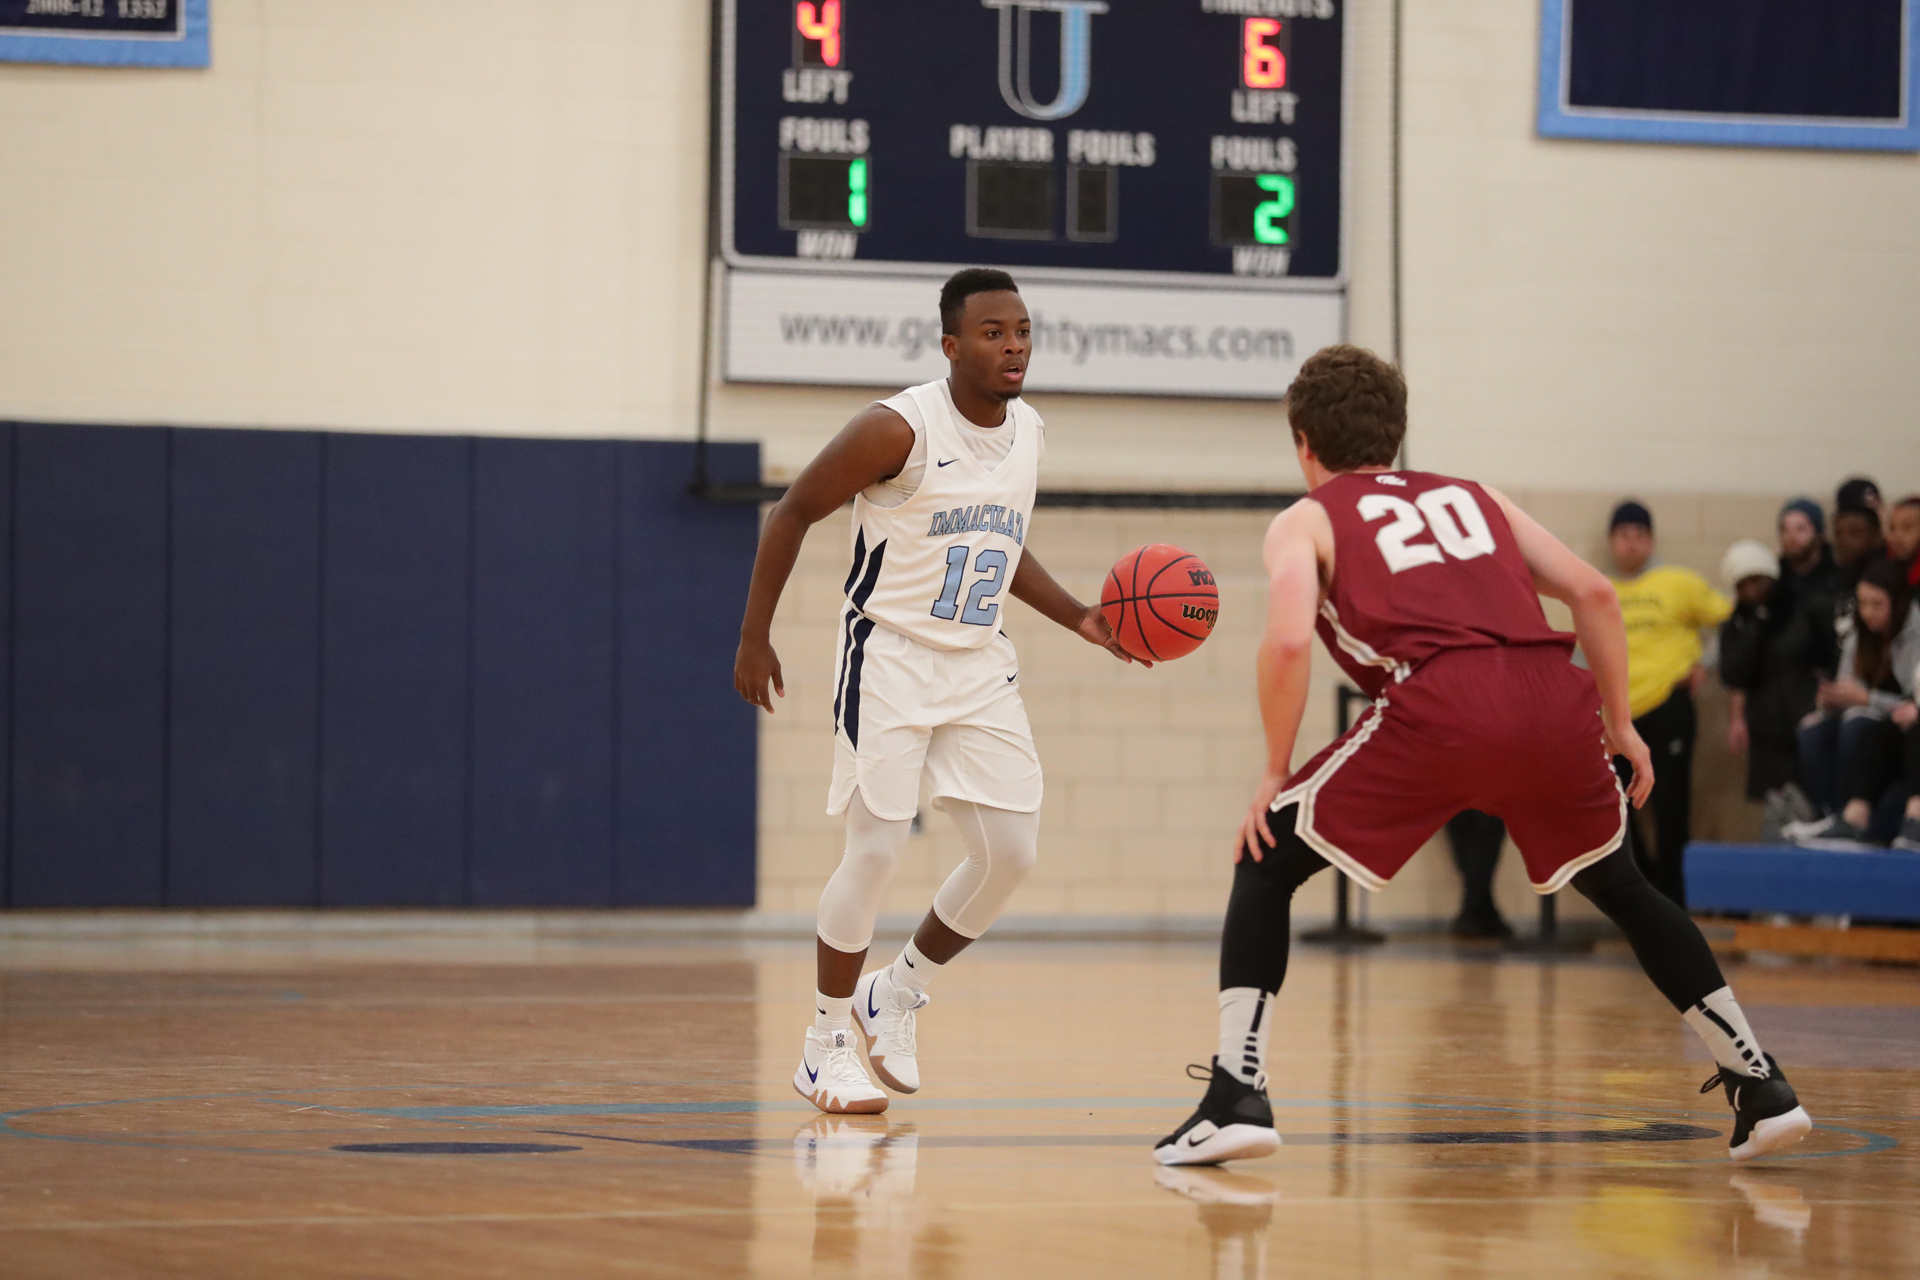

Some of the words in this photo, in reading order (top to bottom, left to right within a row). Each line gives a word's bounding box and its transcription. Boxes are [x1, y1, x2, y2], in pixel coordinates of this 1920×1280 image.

[796, 0, 840, 67] 4
[1244, 17, 1286, 88] 6
[782, 68, 853, 104] LEFT
[1231, 89, 1298, 125] LEFT
[779, 116, 870, 154] FOULS
[950, 124, 1054, 163] PLAYER
[1067, 129, 1156, 167] FOULS
[1210, 134, 1298, 172] FOULS
[848, 157, 867, 227] 1
[1253, 173, 1295, 244] 2
[796, 228, 858, 258] WON
[1232, 245, 1291, 276] WON
[779, 309, 1294, 366] www.ghtymacs.com
[1356, 485, 1496, 574] 20
[930, 545, 1008, 626] 12
